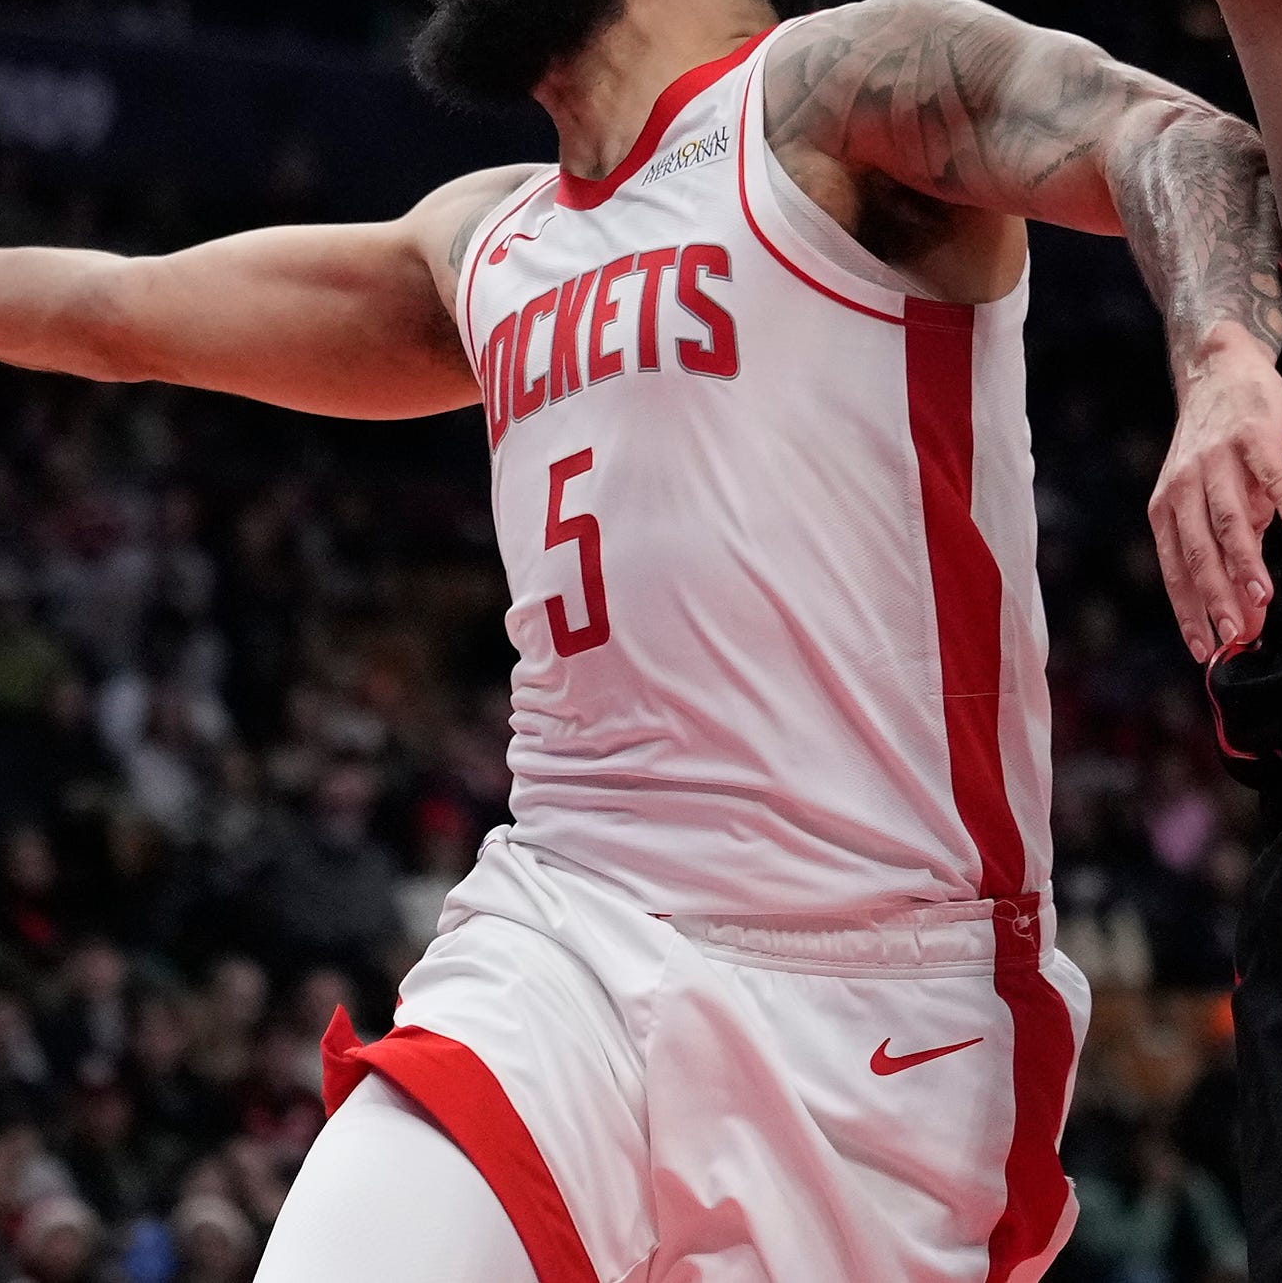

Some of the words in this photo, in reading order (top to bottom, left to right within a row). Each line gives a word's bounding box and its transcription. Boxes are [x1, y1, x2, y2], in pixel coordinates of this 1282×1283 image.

[640, 137, 728, 187] HERMANN
[648, 125, 731, 173] MEMORIAL
[480, 241, 741, 455] OCKETS
[544, 446, 611, 658] 5
